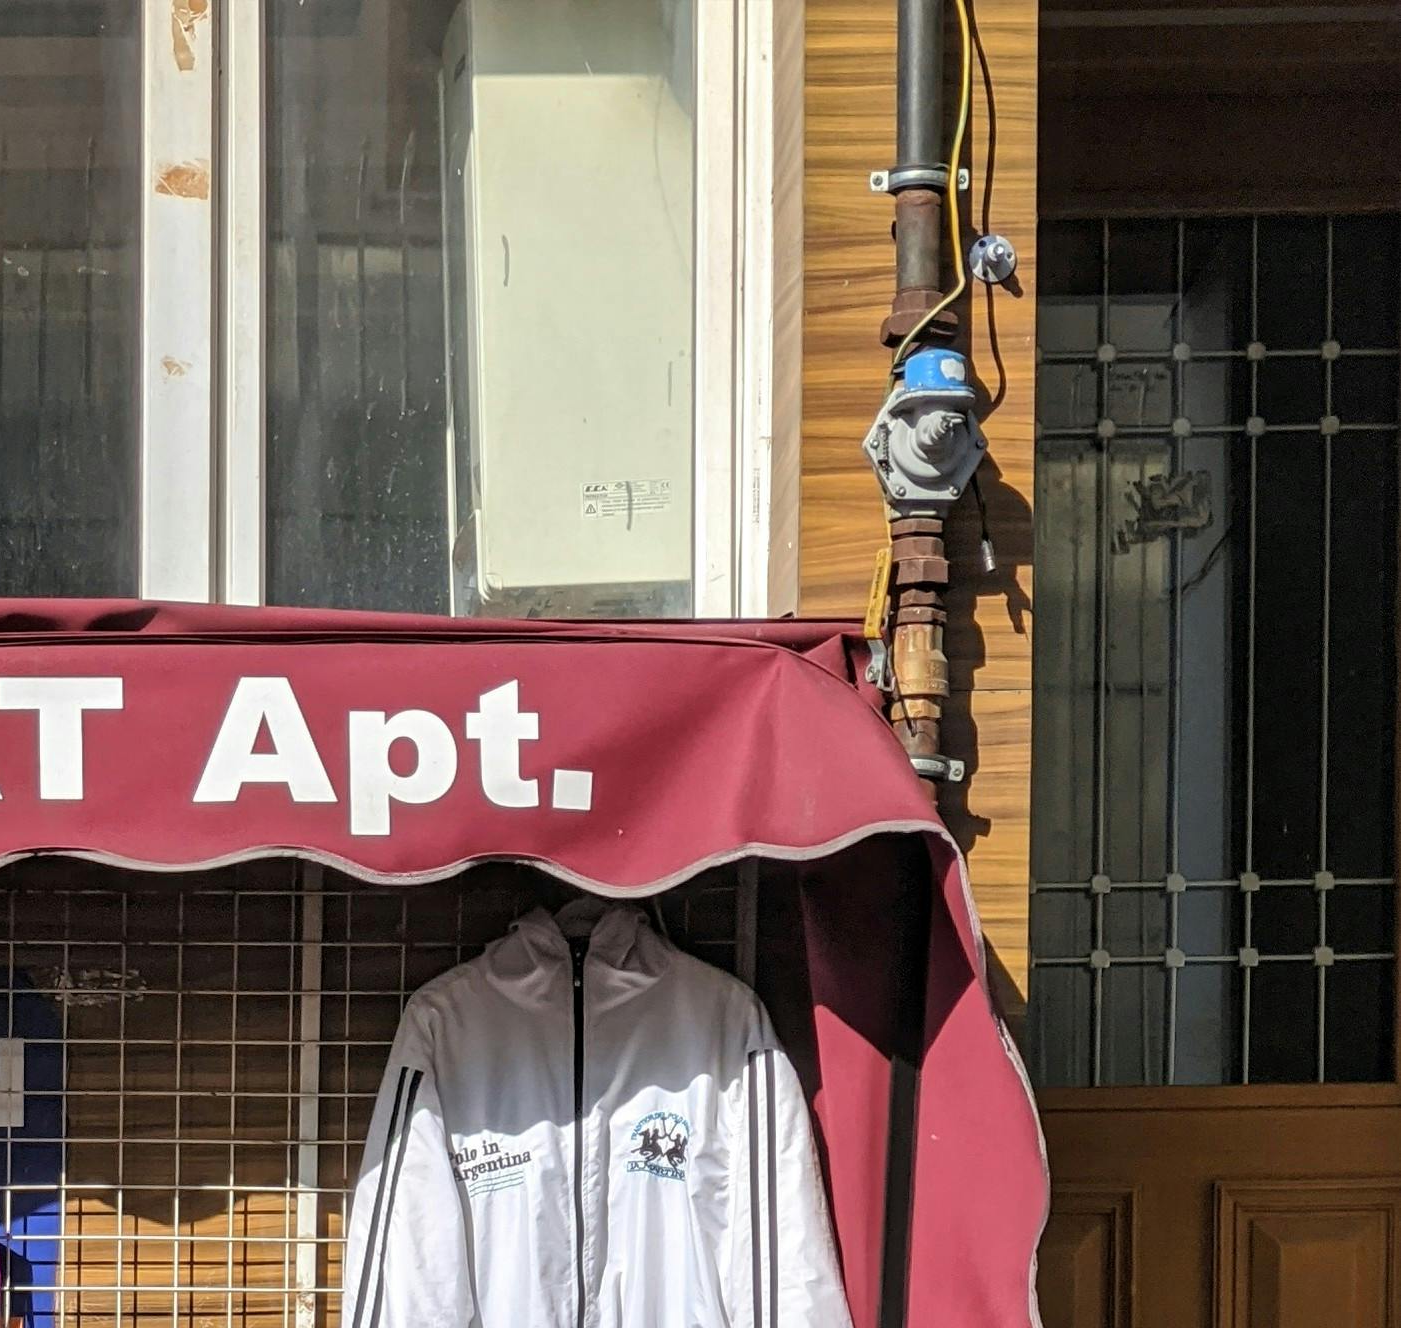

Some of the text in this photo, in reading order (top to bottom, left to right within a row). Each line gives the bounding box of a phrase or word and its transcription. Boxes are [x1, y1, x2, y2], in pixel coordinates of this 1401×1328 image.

[192, 676, 595, 836] Apt.
[482, 1140, 501, 1156] in
[453, 1151, 532, 1182] Argentina
